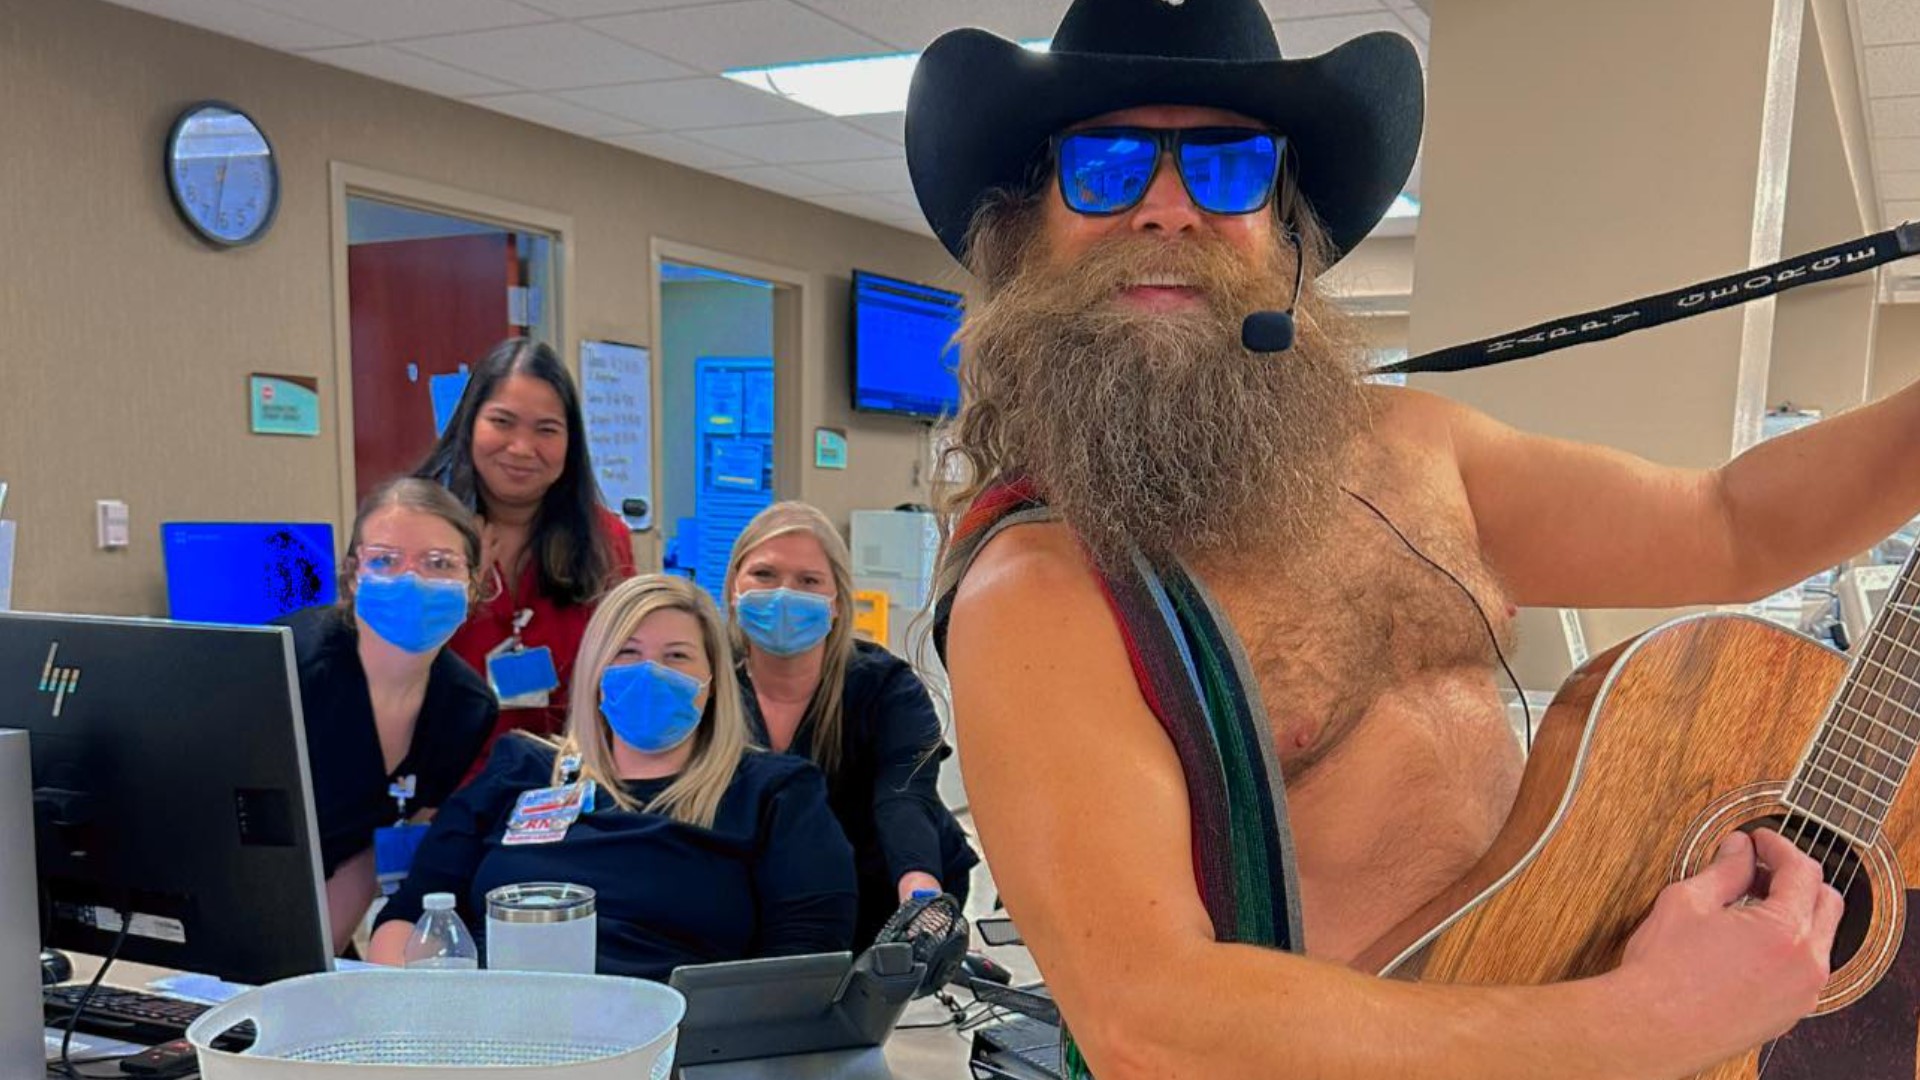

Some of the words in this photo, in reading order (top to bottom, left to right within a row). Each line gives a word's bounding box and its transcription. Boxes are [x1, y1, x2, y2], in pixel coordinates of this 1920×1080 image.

[1486, 308, 1641, 354] HAPPY
[1676, 246, 1876, 308] GEORGE
[39, 642, 80, 717] hp
